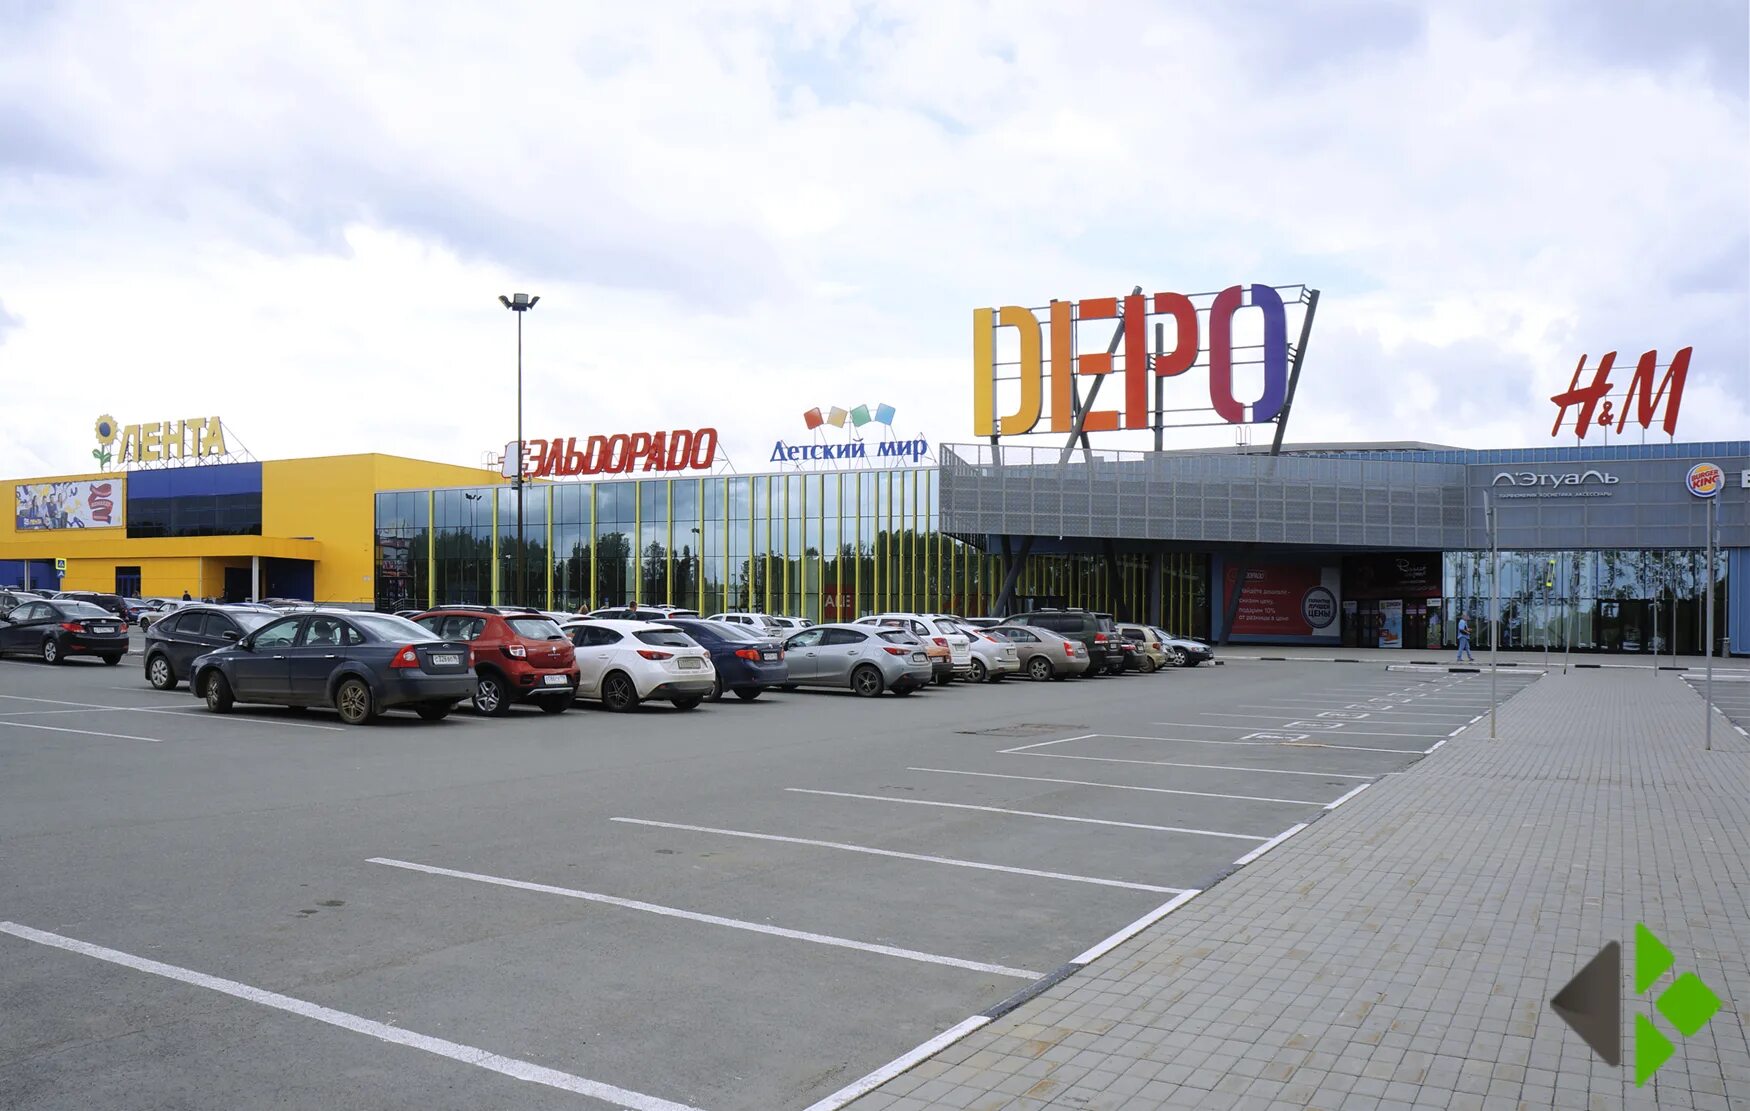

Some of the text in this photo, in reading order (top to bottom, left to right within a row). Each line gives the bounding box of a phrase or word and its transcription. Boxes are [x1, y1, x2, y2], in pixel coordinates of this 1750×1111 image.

[974, 284, 1288, 436] DEPO
[1551, 346, 1693, 439] H&M
[117, 415, 227, 464] ЛЕНТА
[770, 438, 928, 463] Детский мир
[1691, 469, 1719, 481] BURGER
[1692, 475, 1720, 489] KING
